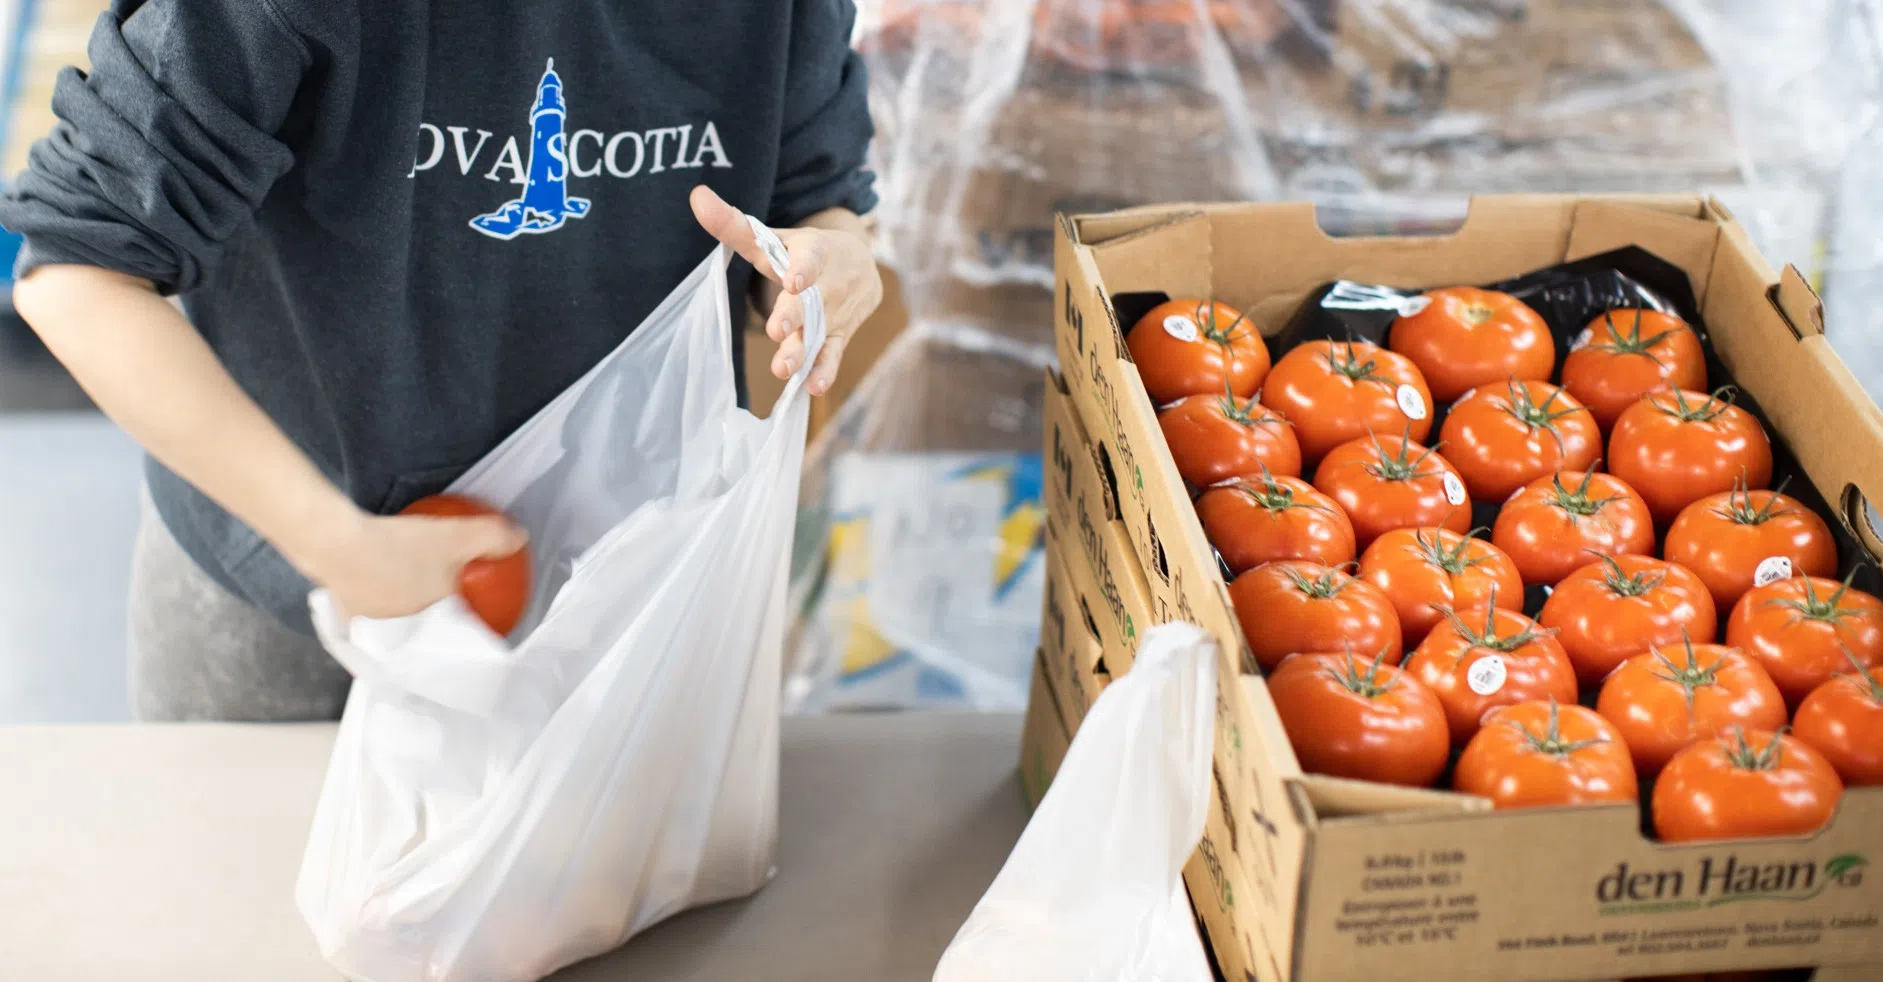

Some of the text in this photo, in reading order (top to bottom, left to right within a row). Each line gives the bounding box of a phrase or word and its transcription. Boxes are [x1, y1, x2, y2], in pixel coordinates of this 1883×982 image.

[546, 121, 733, 182] SCOTIA
[1595, 861, 1684, 902] den
[1697, 853, 1817, 896] Haan
